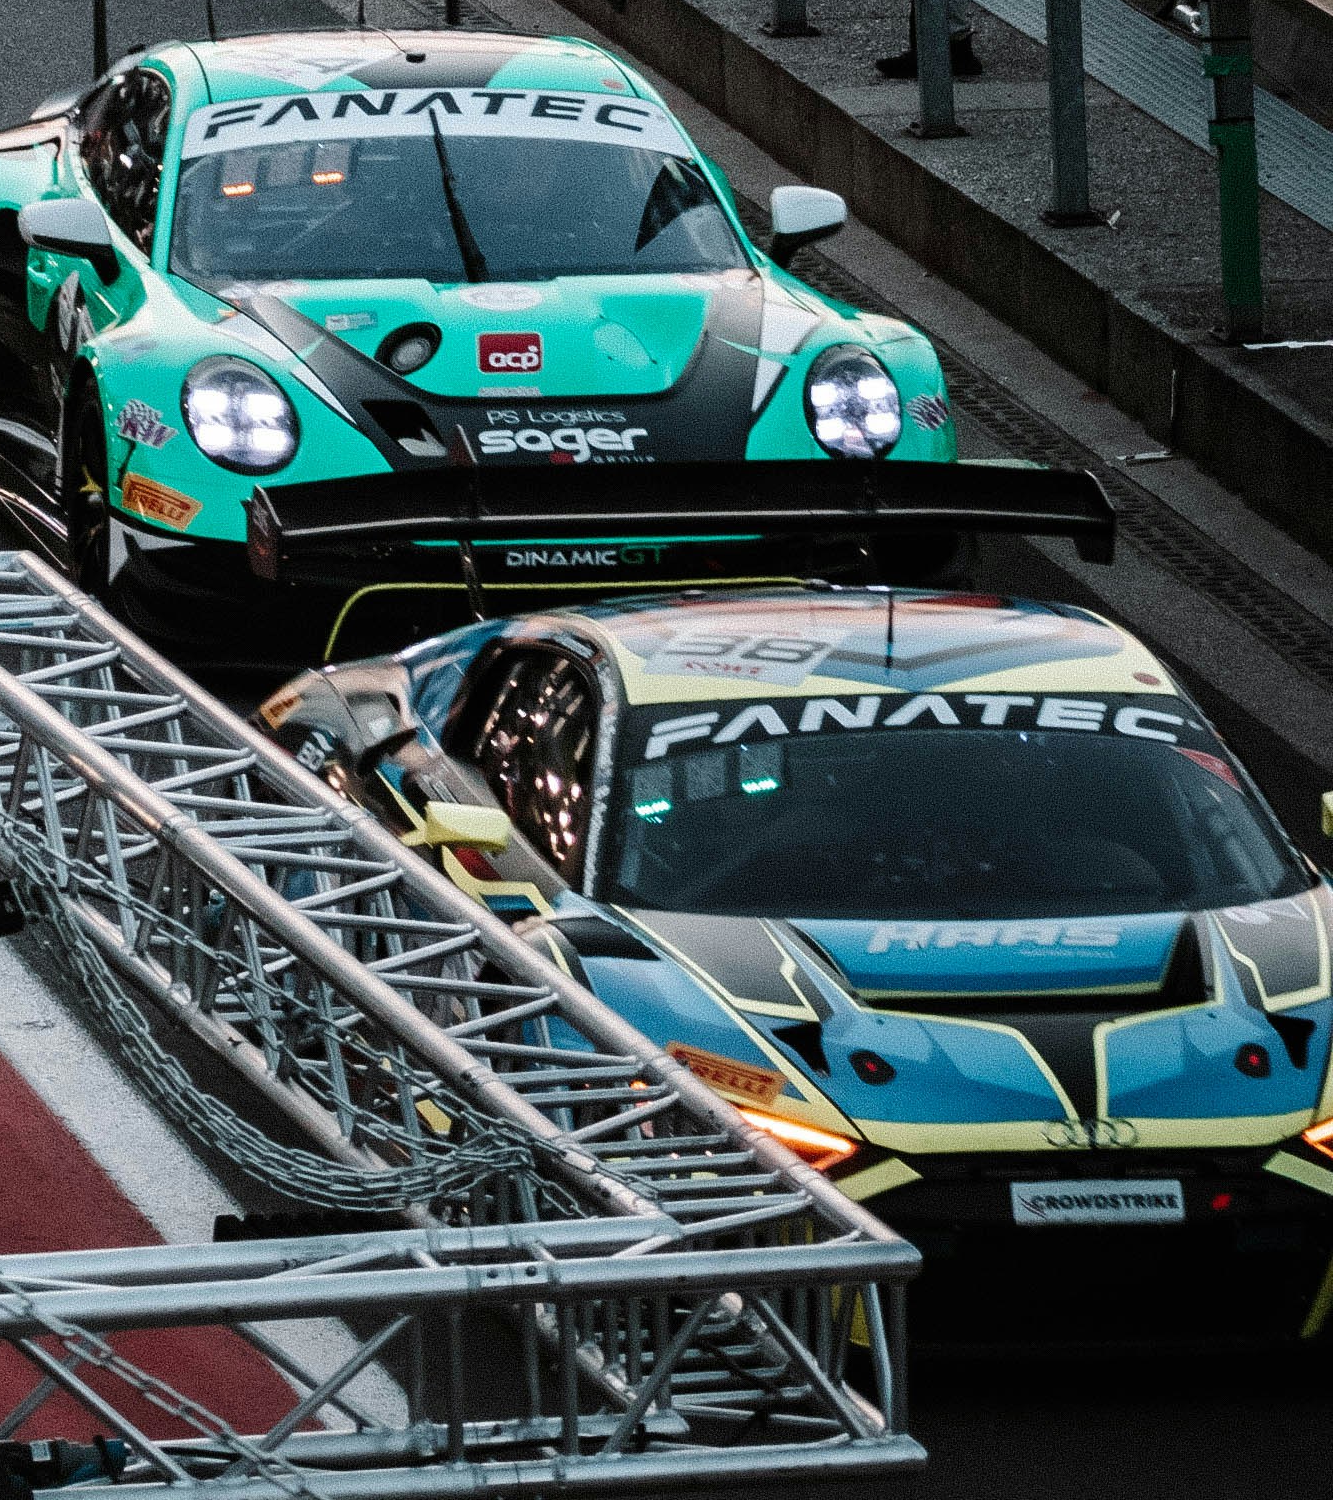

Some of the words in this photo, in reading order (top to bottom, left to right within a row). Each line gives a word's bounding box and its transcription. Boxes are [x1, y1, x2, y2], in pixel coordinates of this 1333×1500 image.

[205, 91, 656, 139] FANATEC
[486, 410, 521, 425] PS
[528, 409, 627, 427] Logistics
[477, 427, 649, 463] sager
[505, 550, 618, 567] DINAMIC
[644, 693, 1188, 761] FANATEC
[867, 920, 1128, 954] HAAS
[1035, 1190, 1180, 1215] CROWDSTRIKE
